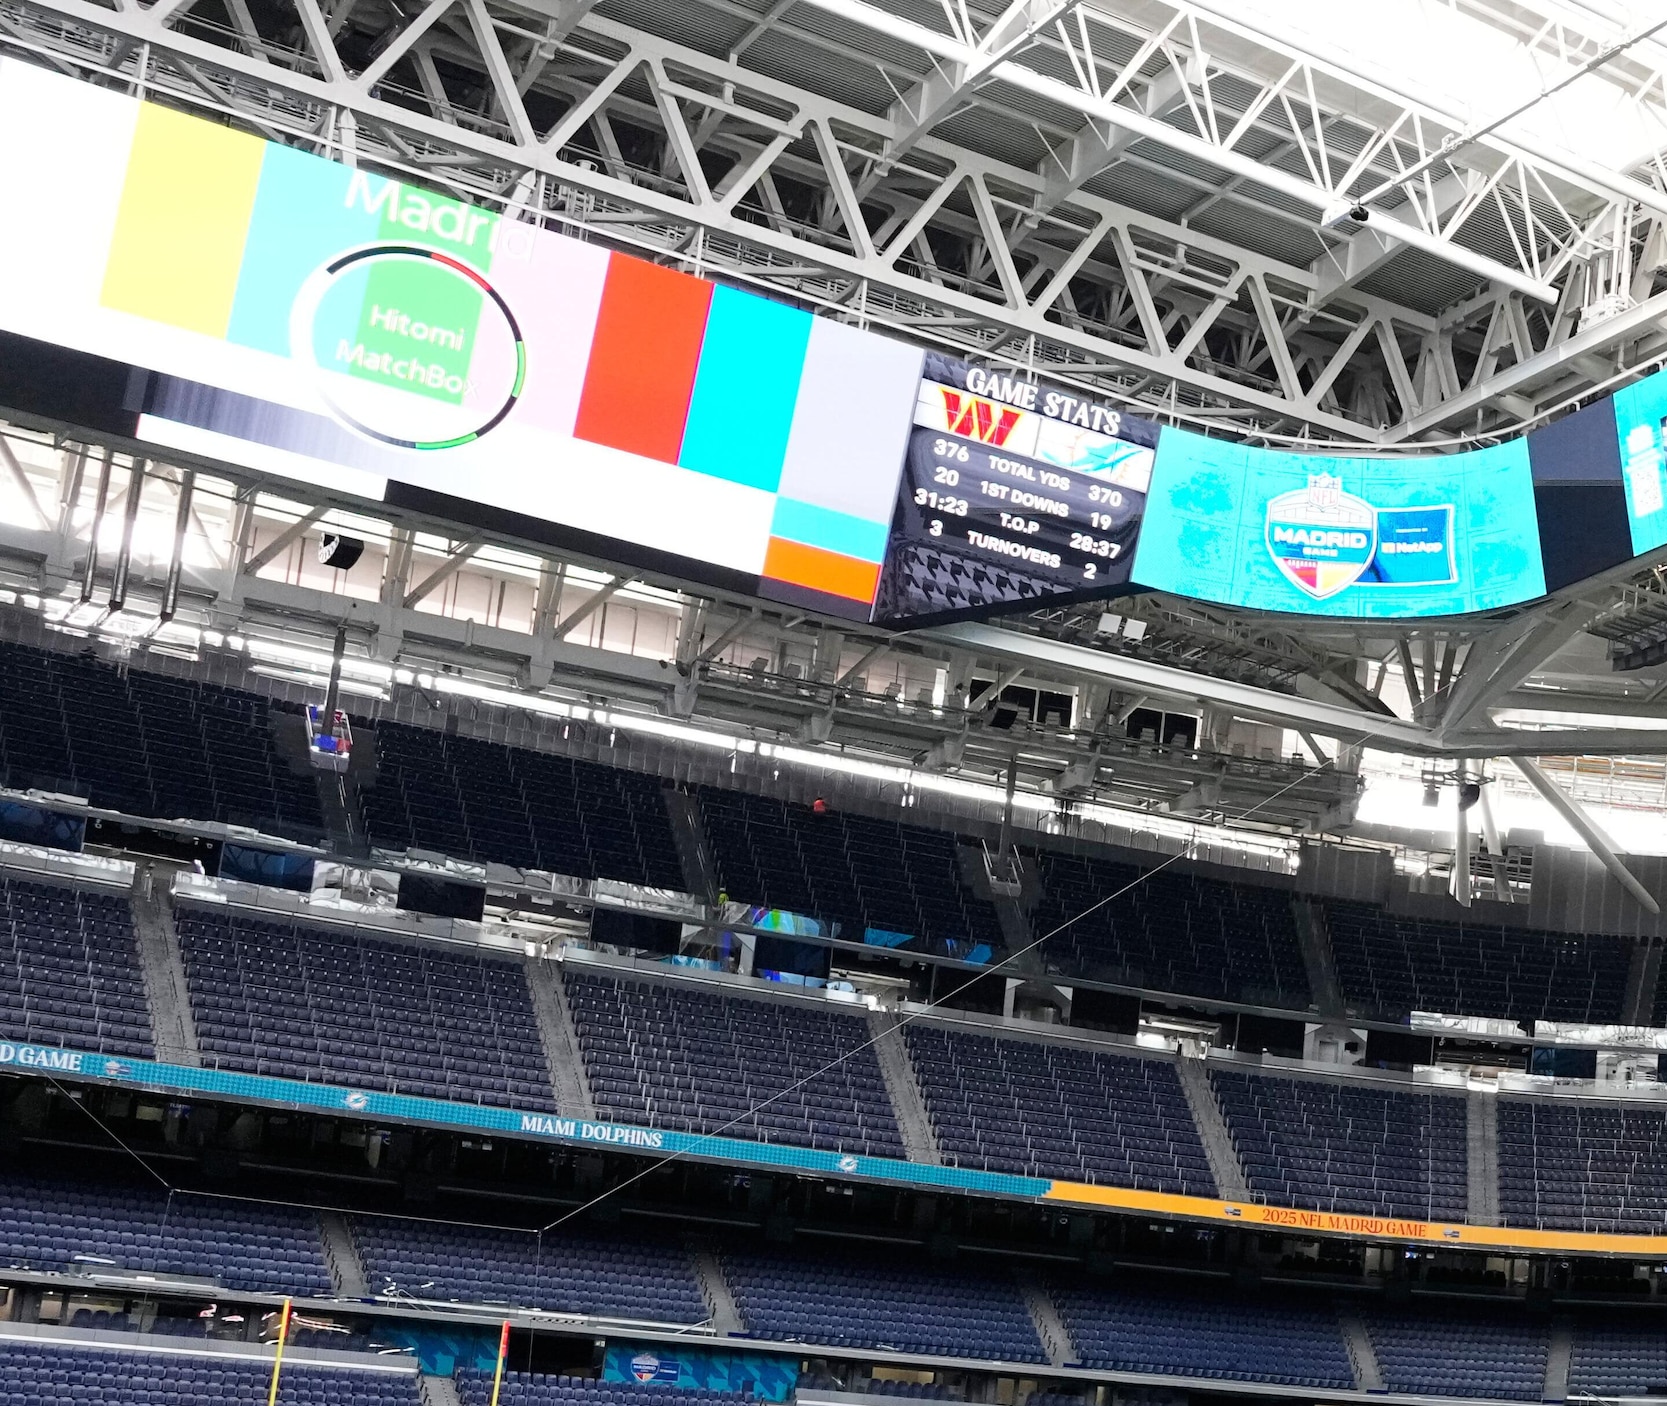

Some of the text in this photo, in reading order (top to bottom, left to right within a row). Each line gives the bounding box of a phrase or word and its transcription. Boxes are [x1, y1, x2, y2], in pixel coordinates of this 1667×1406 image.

[369, 304, 465, 352] Hitomi
[335, 339, 479, 399] MatchBox
[966, 367, 1121, 435] GAME STATS
[934, 439, 1123, 508] 376 TOTAL YDS 370
[934, 467, 1112, 531] 20 1ST DOWNS 19
[914, 488, 1122, 560] 31:23 T.O.P 28:37
[929, 520, 1098, 580] 3 TURNOVERS 2
[1273, 526, 1368, 550] MADRID
[18, 1047, 82, 1071] GAME
[521, 1116, 663, 1148] MIAMI DOLPHINS
[1262, 1208, 1427, 1237] 2025 NFL MADRID GAME
